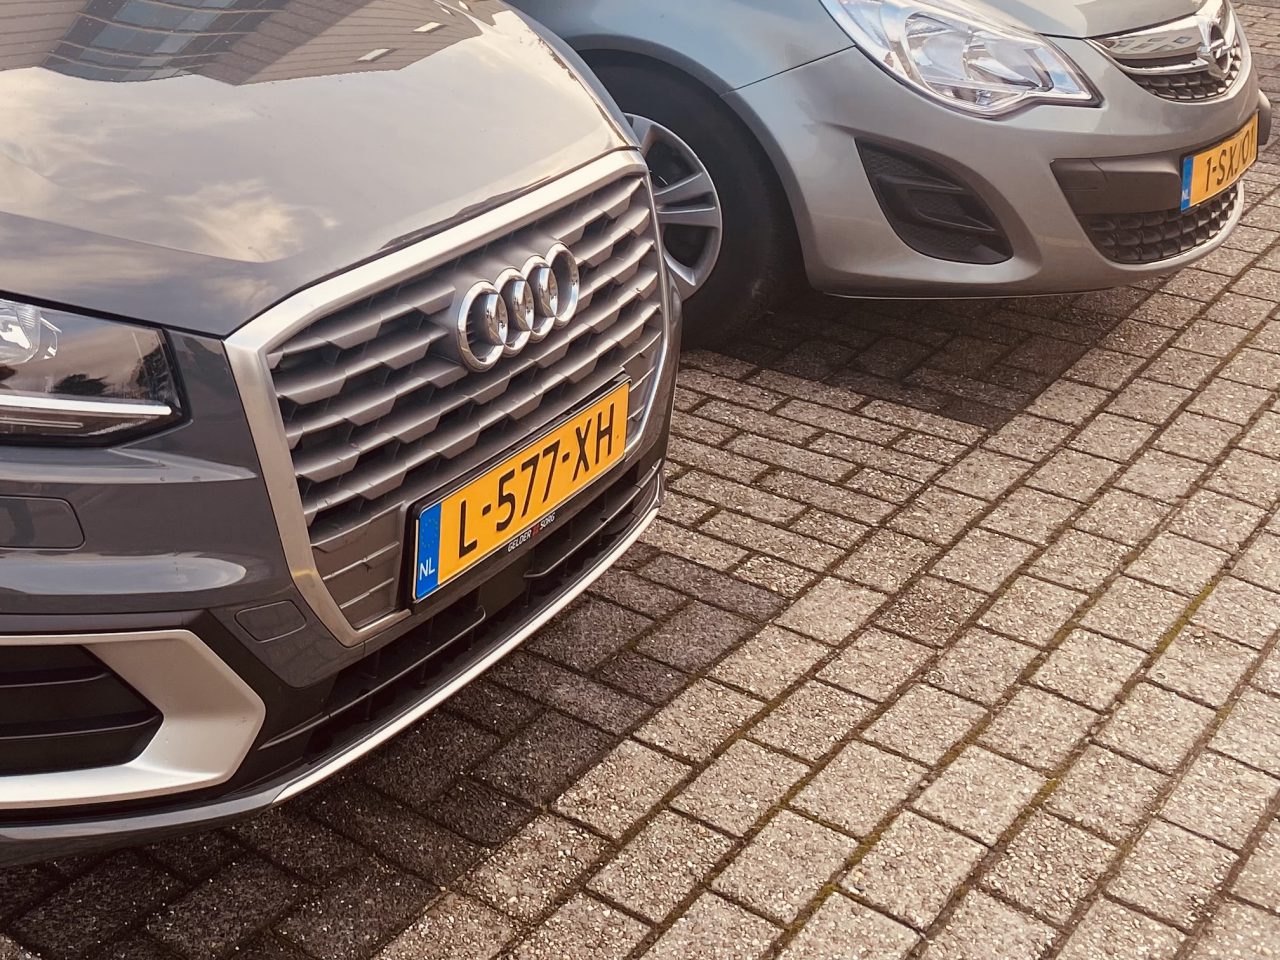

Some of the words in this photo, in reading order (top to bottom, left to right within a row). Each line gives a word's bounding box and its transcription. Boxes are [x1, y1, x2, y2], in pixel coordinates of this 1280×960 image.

[419, 560, 435, 581] NL
[458, 402, 616, 559] L-577-XH
[507, 529, 533, 553] GELDER
